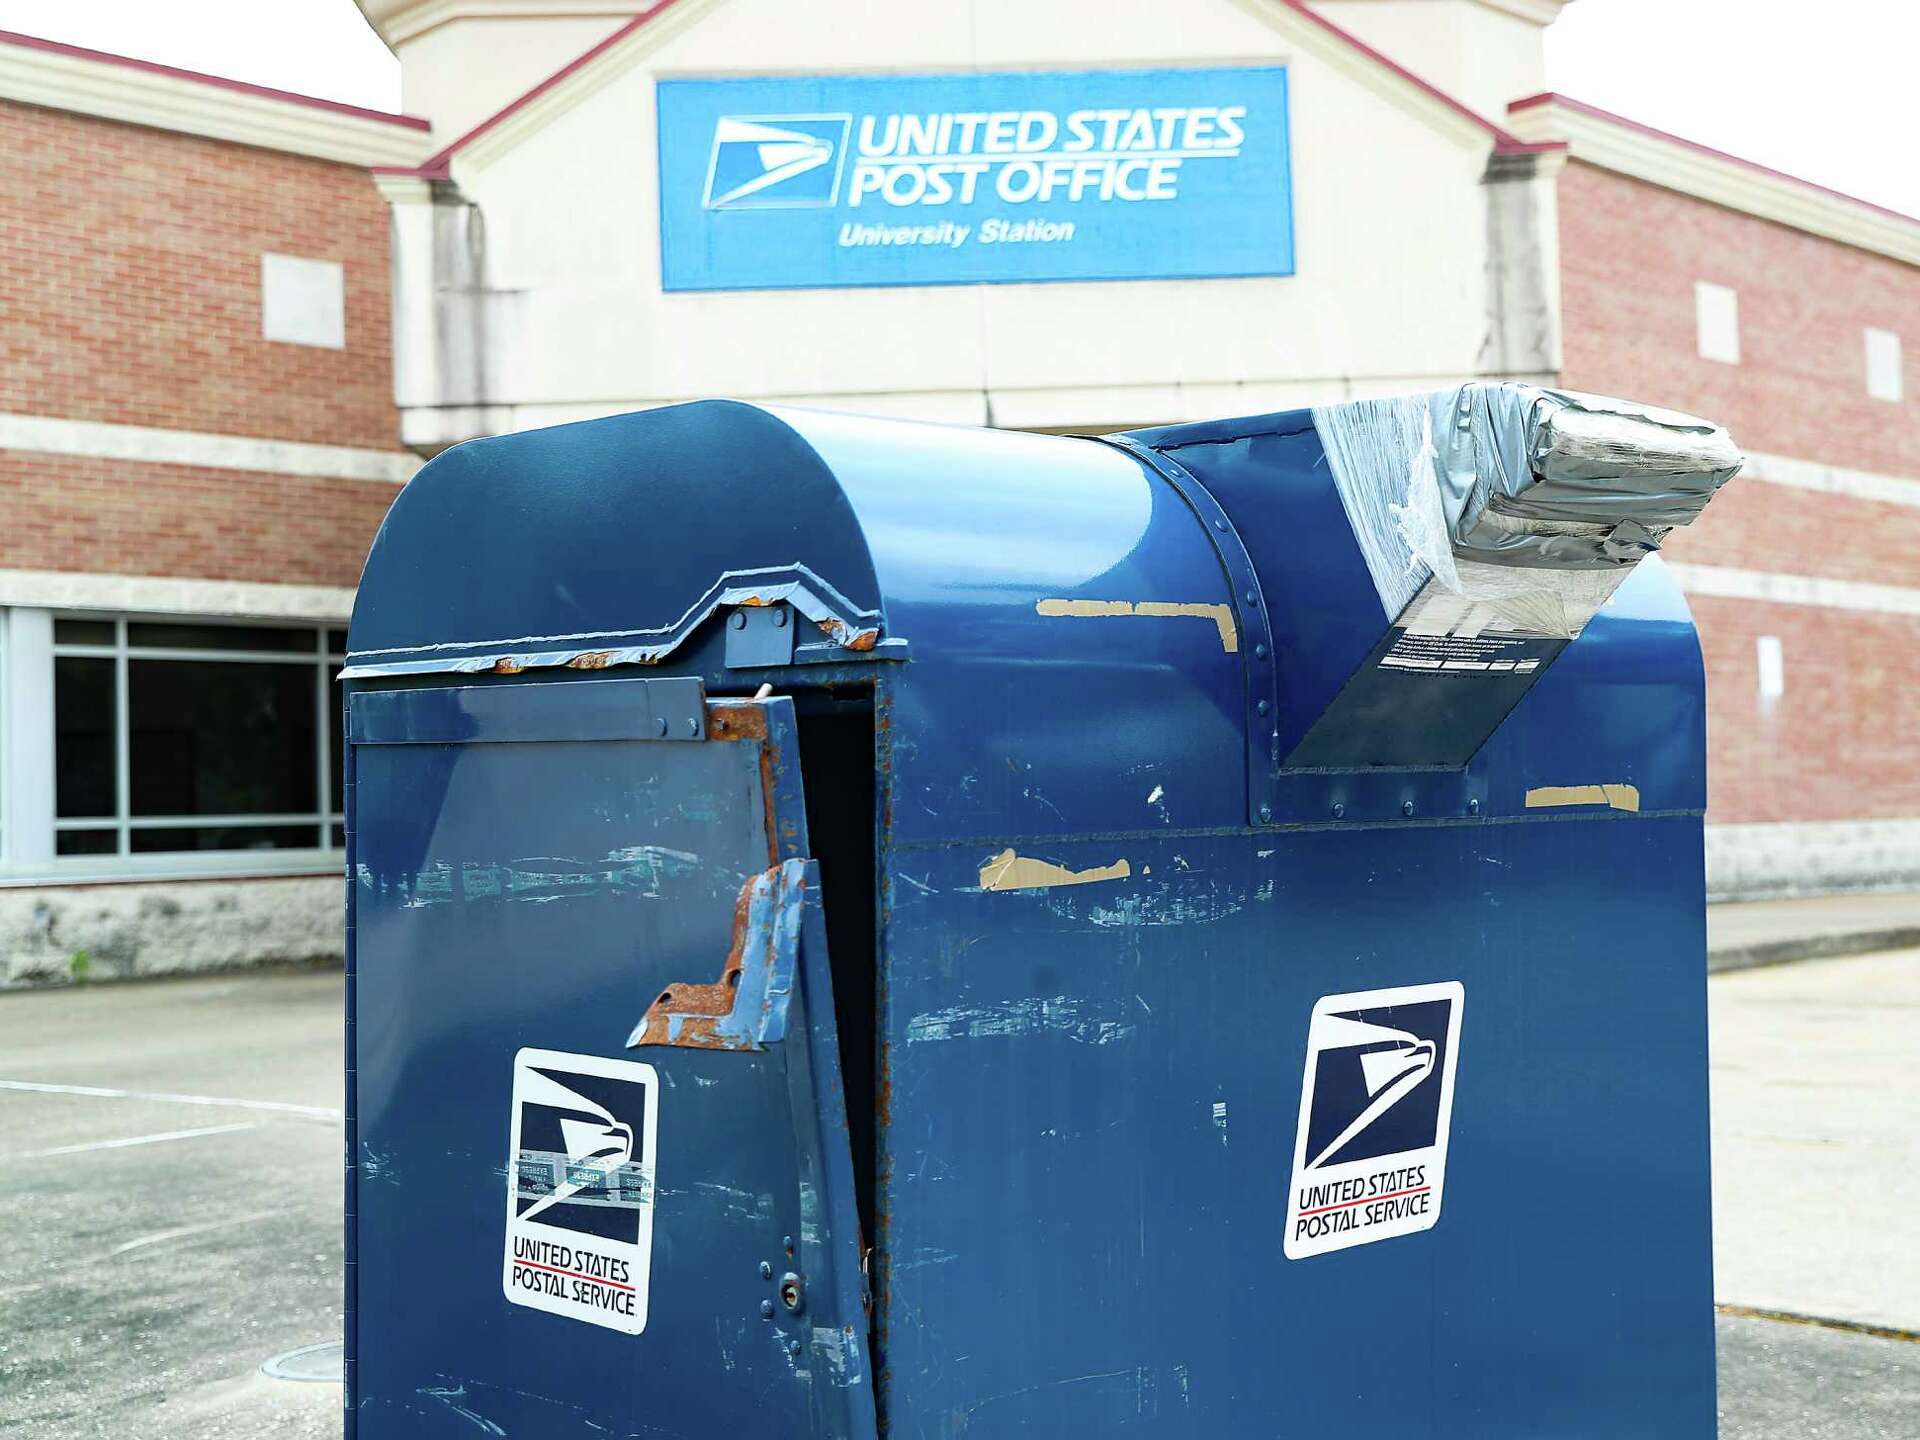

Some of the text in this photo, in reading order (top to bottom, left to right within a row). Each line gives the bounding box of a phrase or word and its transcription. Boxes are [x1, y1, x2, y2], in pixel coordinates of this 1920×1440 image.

[858, 105, 1248, 157] UNITED STATES
[849, 158, 1181, 208] POST OFFICE
[839, 218, 1075, 249] University Station
[1300, 1165, 1425, 1210] UNITED STATES
[1296, 1192, 1430, 1241] POSTAL SERVICE
[514, 1236, 629, 1283] UNITED STATES
[512, 1265, 637, 1316] POSTAL SERVICE
